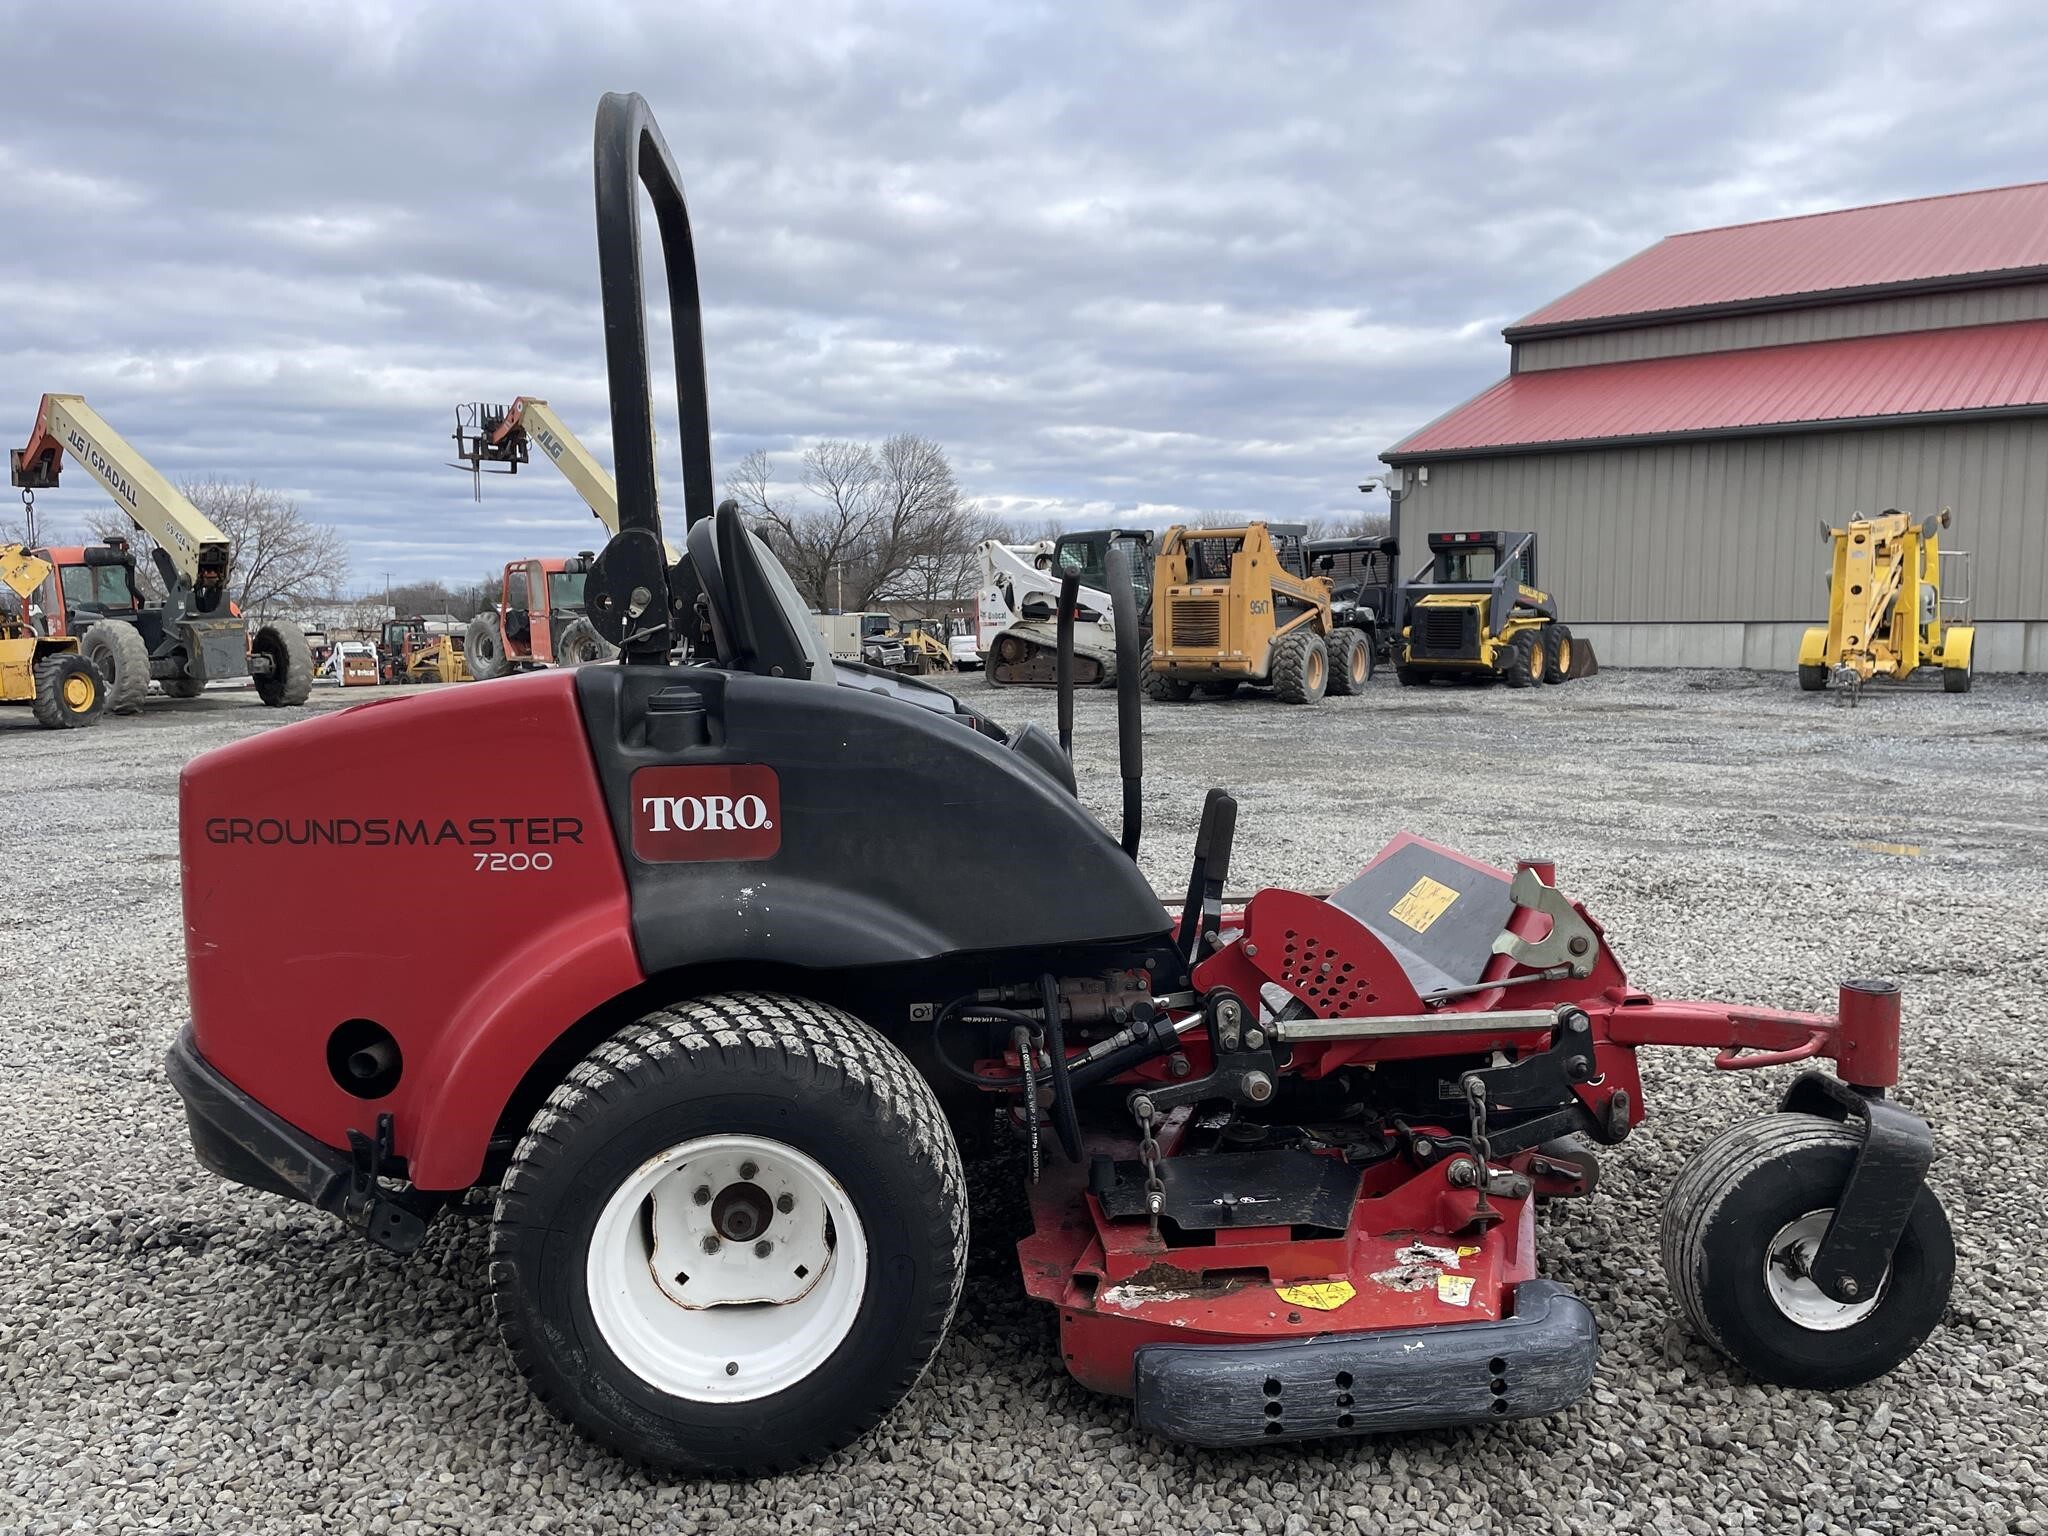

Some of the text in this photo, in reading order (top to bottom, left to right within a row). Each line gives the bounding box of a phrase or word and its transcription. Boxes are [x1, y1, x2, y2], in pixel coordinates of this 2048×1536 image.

[537, 430, 563, 459] JLG
[68, 429, 137, 508] JLG GRADALL
[206, 817, 584, 846] GROUNDSMASTER
[473, 852, 553, 871] 7200
